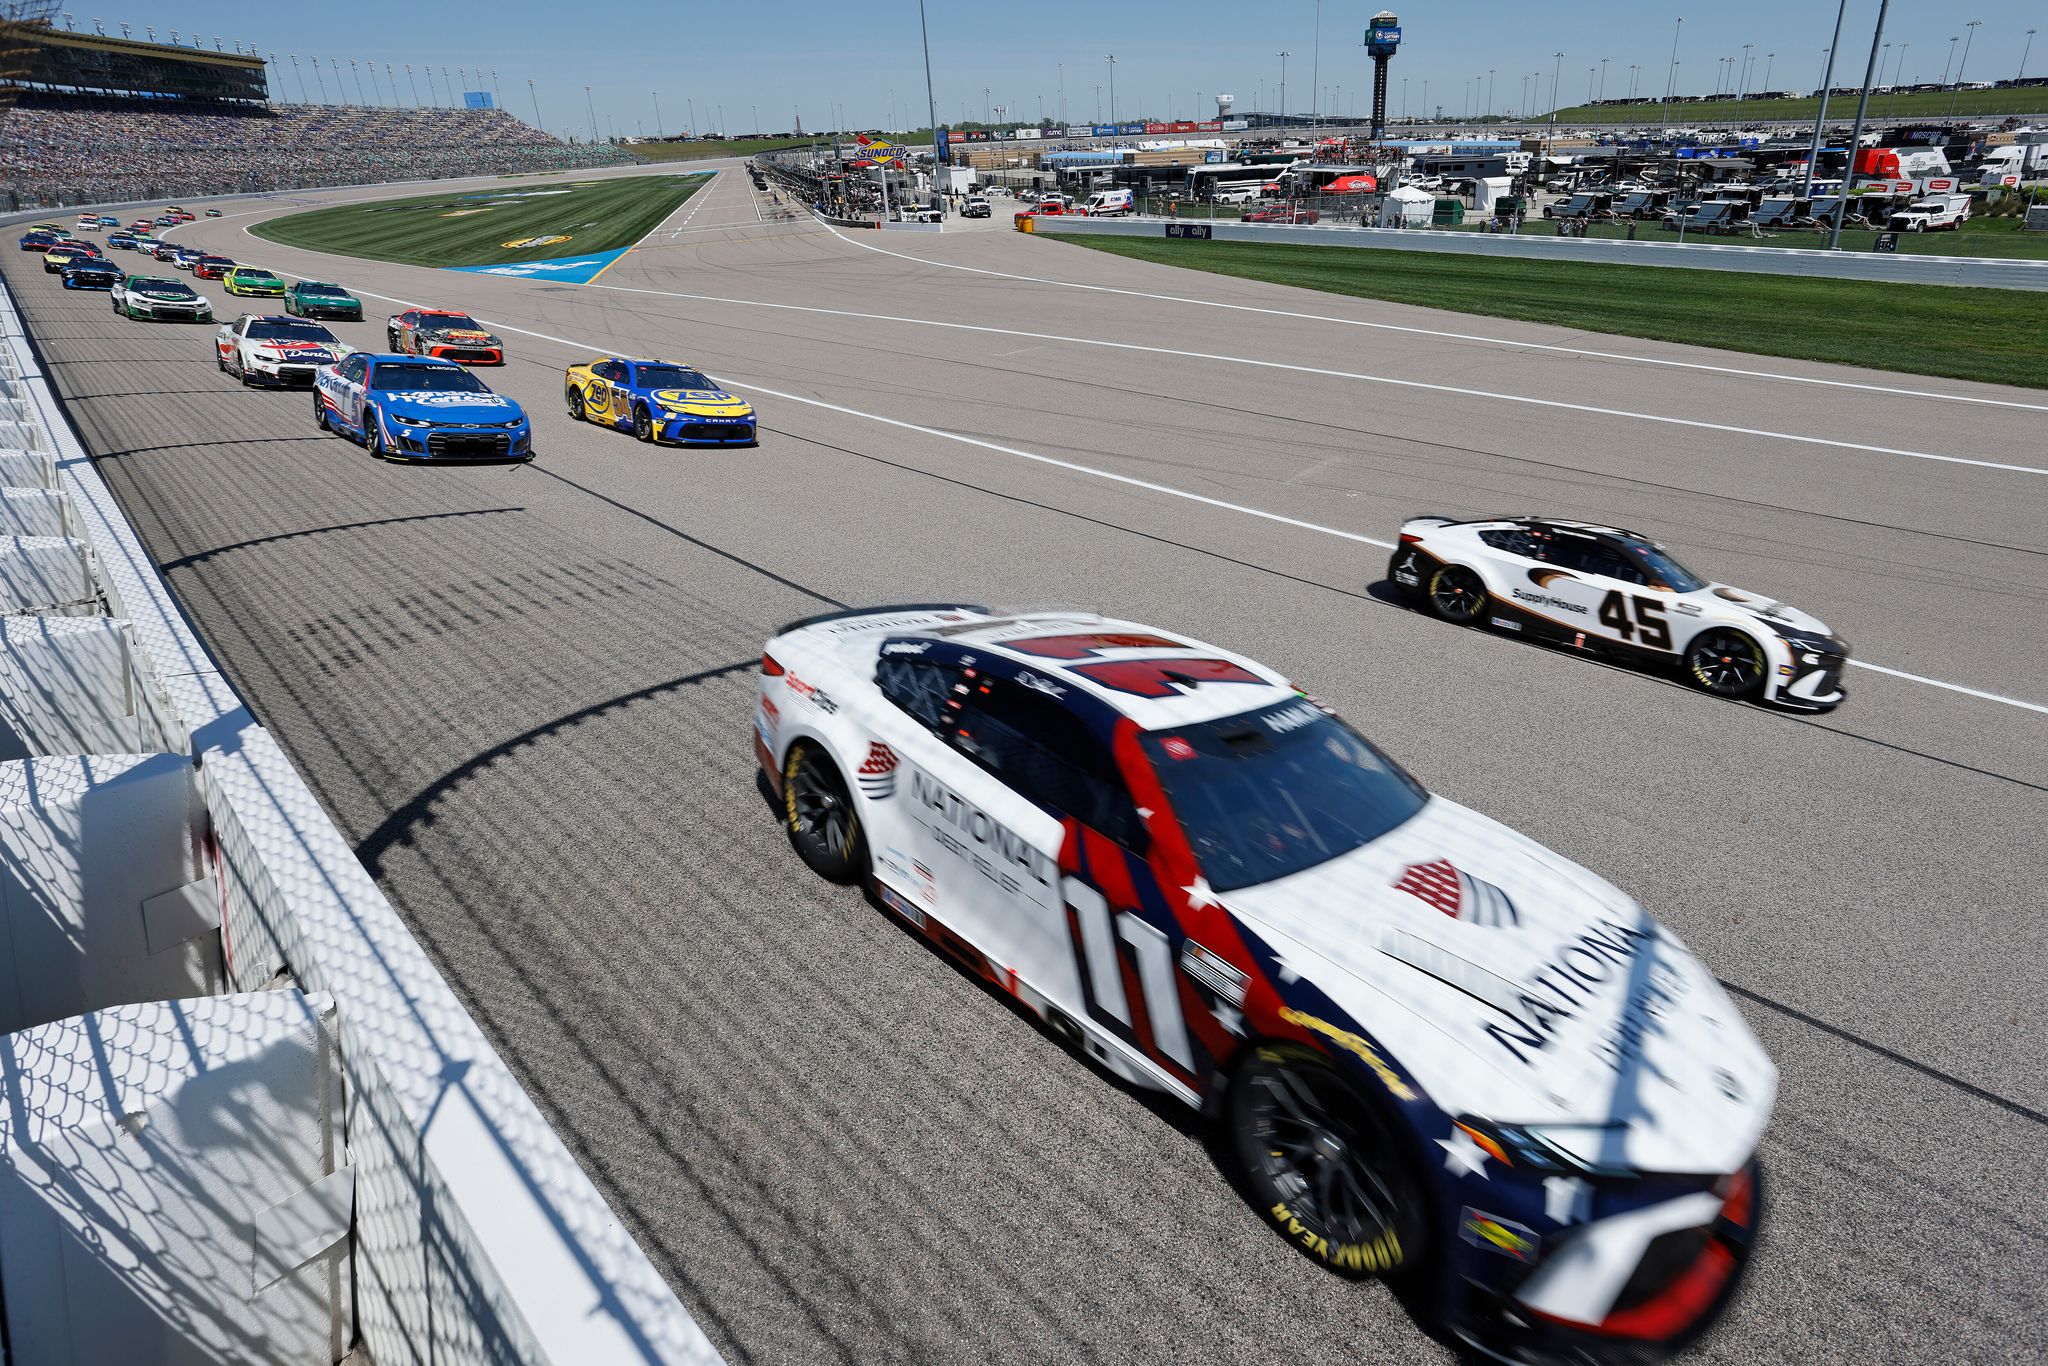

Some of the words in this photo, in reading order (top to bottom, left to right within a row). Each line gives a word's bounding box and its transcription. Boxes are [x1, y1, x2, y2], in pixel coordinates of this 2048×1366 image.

[1911, 131, 1942, 139] NASCAR
[860, 148, 903, 158] SUNOCO
[1169, 225, 1185, 237] ally
[1192, 226, 1207, 238] ally
[611, 388, 633, 423] 54
[401, 429, 412, 437] 5
[1512, 588, 1589, 614] SupplyHouse
[1597, 589, 1673, 651] 45
[911, 770, 1052, 889] NATIONAL
[1062, 874, 1197, 1075] 11
